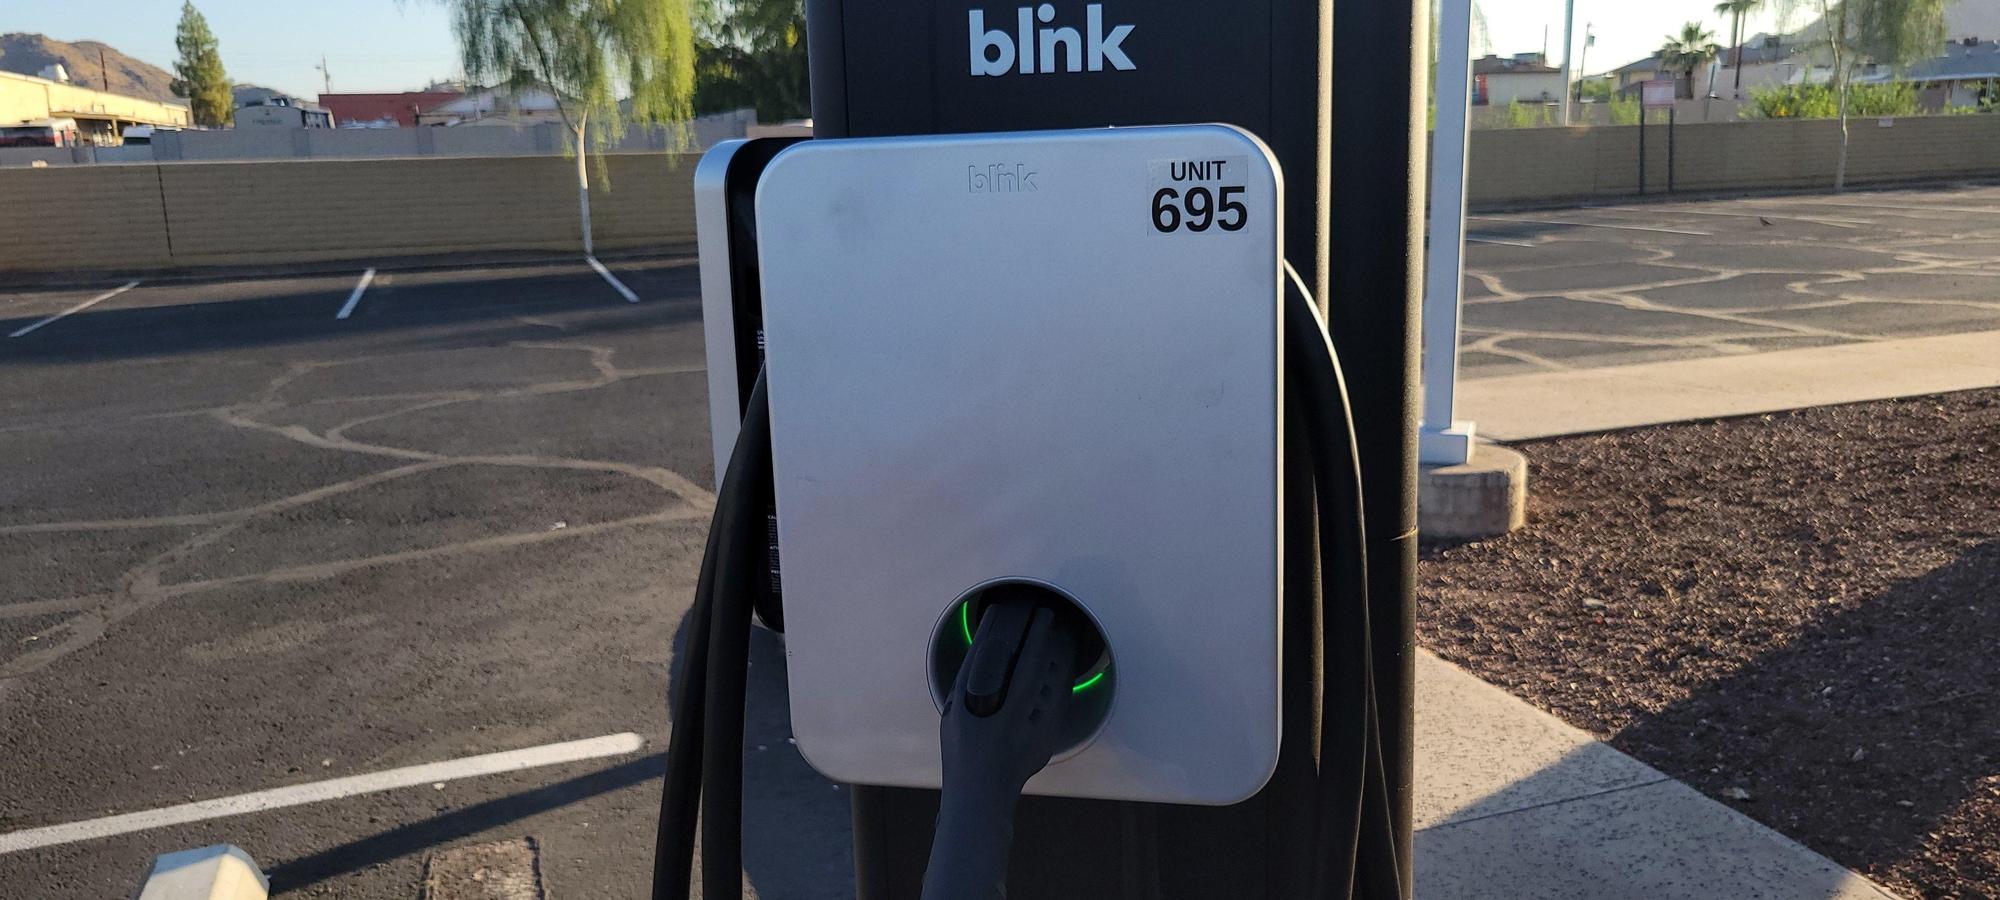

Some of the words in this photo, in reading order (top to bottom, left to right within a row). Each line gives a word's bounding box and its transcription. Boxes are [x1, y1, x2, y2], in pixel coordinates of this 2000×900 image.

[969, 3, 1137, 77] blink
[968, 163, 1038, 193] blink
[1171, 161, 1226, 181] UNIT
[1152, 186, 1248, 233] 695
